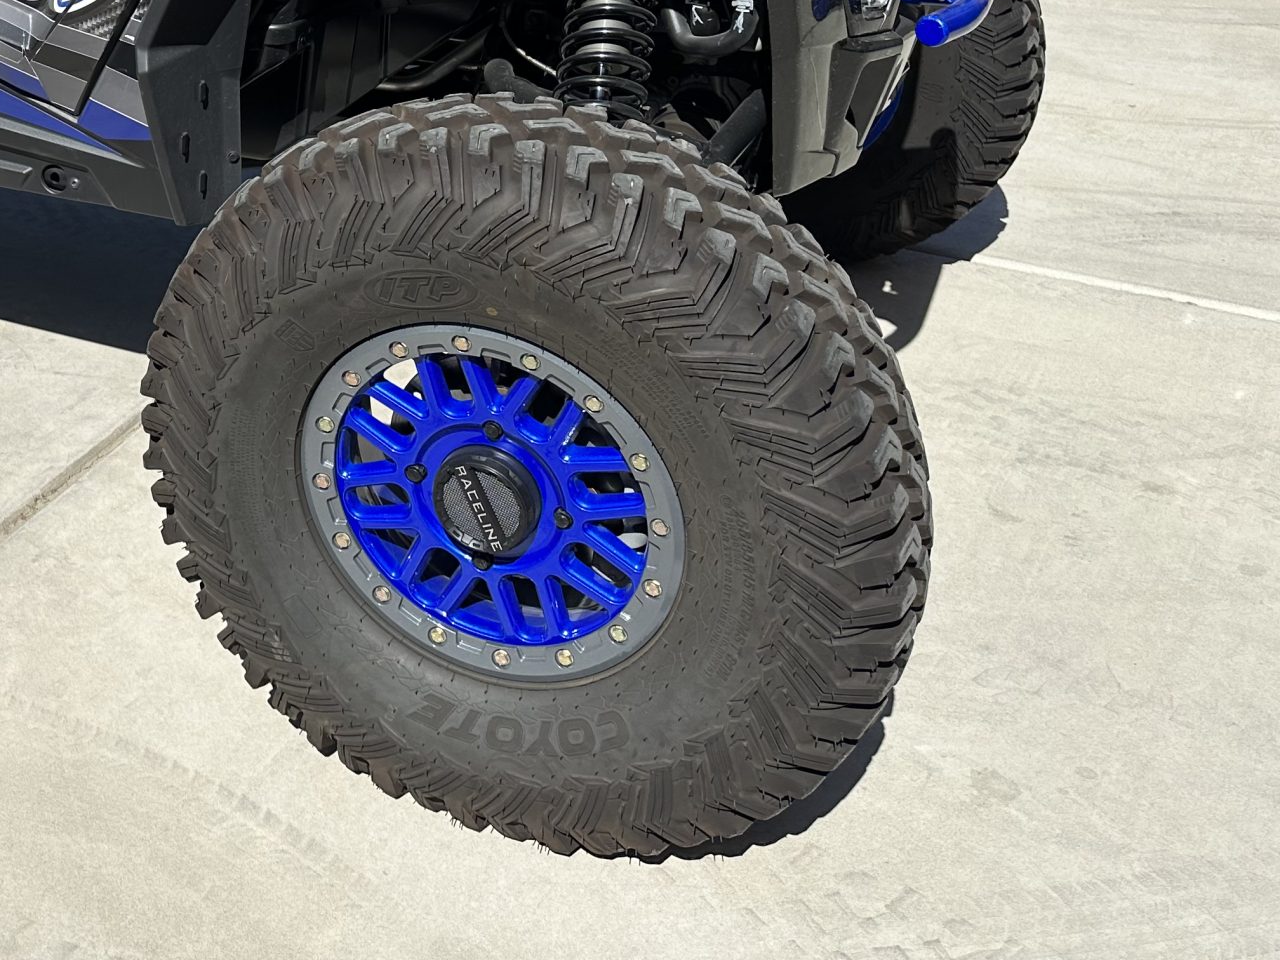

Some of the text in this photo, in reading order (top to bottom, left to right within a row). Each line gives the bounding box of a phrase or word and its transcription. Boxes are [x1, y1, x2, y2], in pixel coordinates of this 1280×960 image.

[378, 275, 462, 303] ITP
[455, 465, 503, 552] RACELINE
[406, 692, 630, 757] COYOTE
